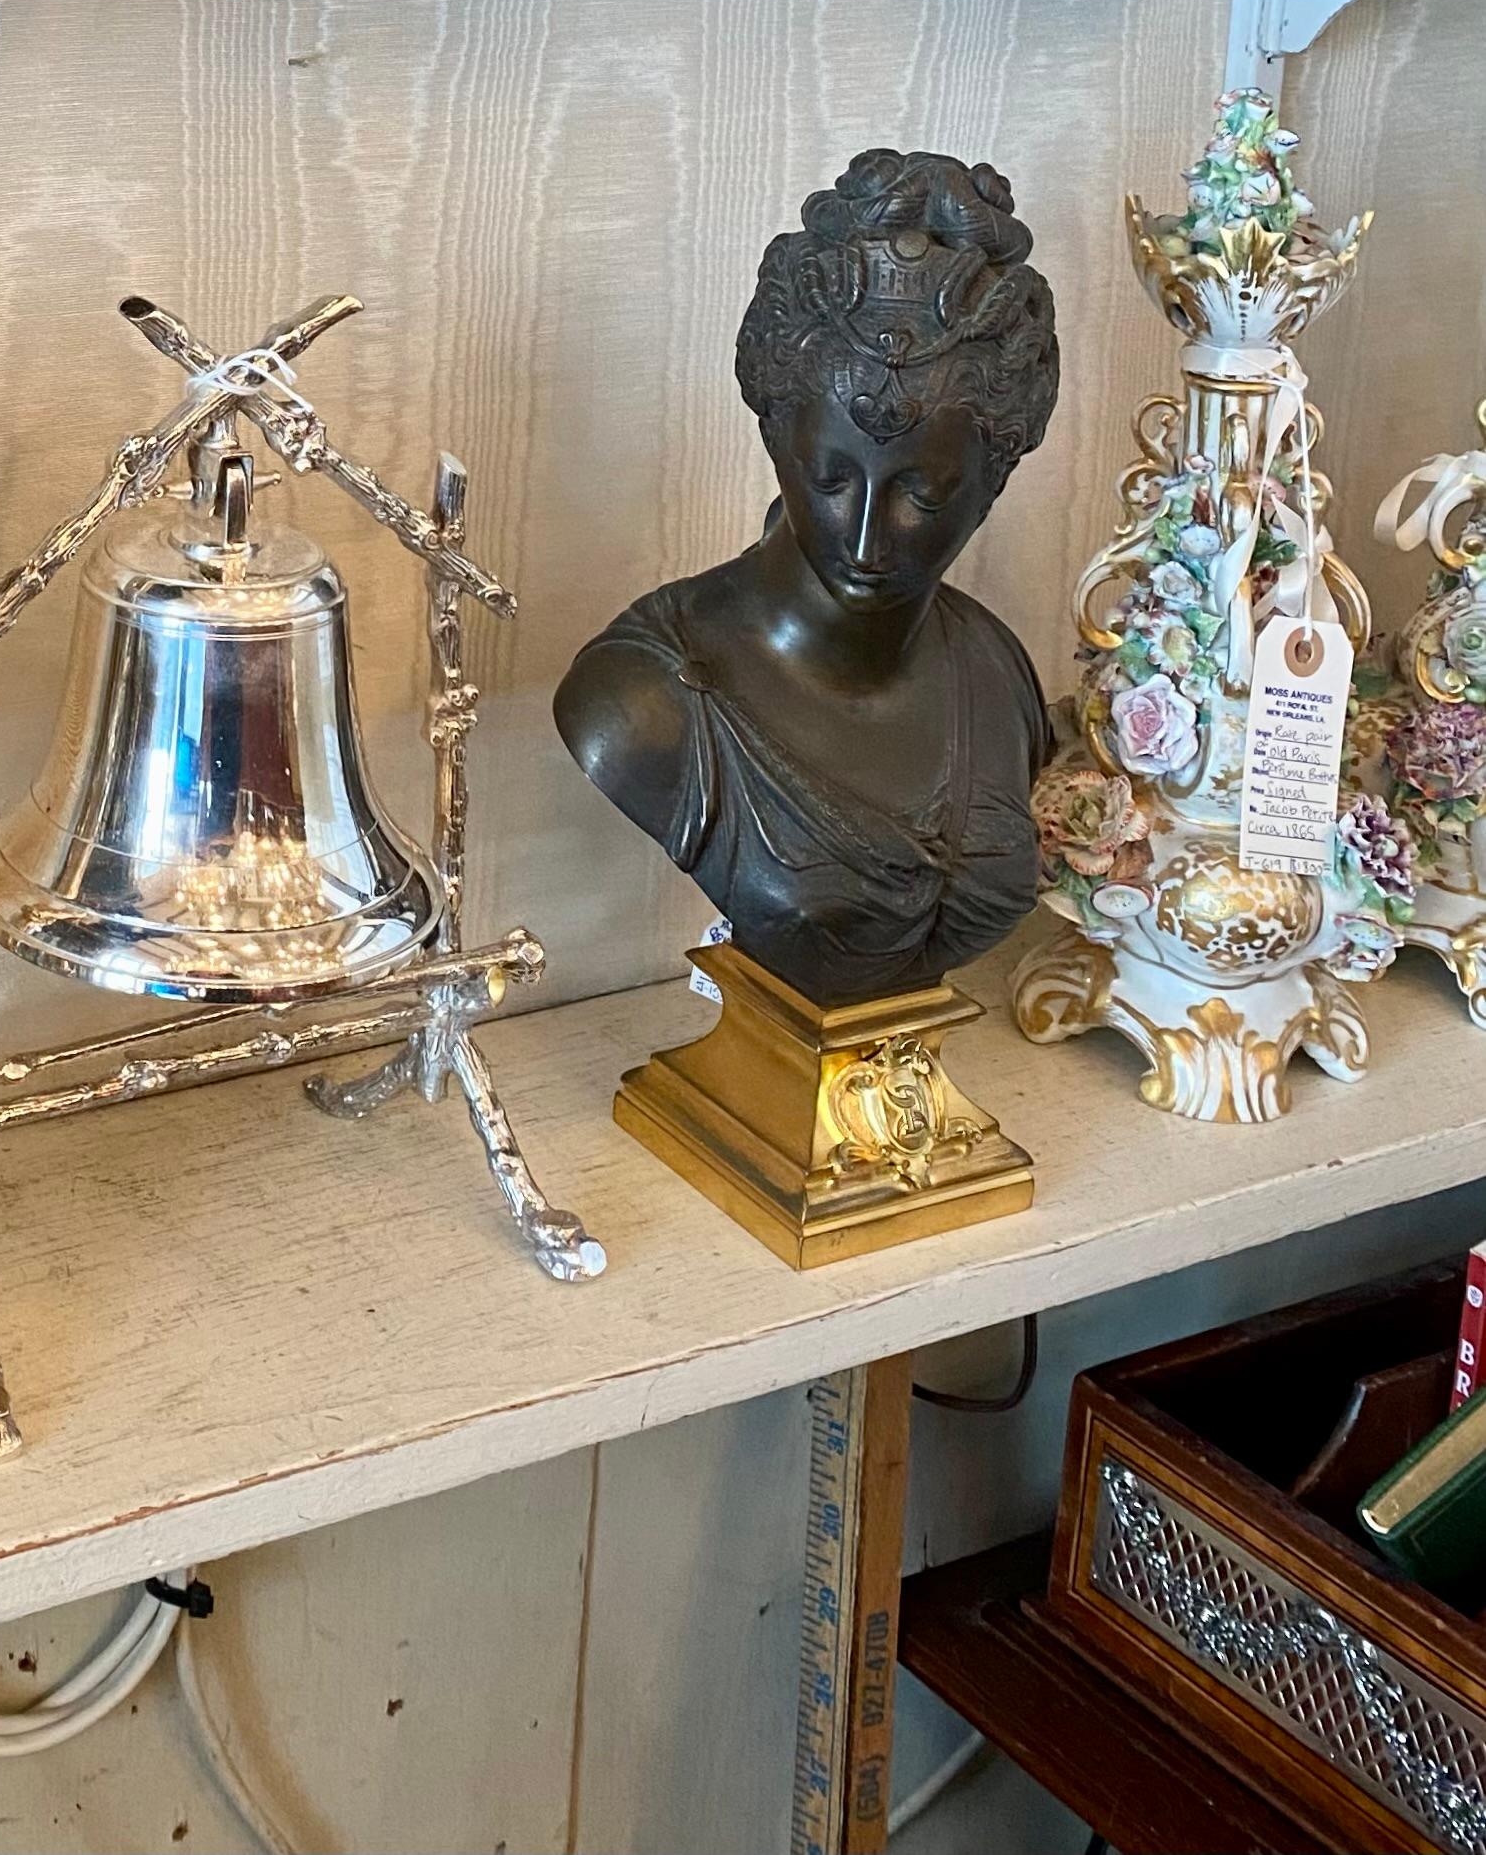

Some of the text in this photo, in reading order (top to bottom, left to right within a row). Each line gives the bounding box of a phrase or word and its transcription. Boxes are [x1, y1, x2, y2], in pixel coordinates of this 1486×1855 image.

[1265, 686, 1333, 704] MOSS ANTIQUES
[1306, 729, 1333, 746] pair
[1267, 780, 1307, 803] Signed
[1263, 800, 1298, 815] Jacob
[1286, 823, 1316, 840] 1865
[827, 1419, 847, 1456] 31
[818, 1586, 837, 1626] 29
[814, 1672, 834, 1709] 28
[808, 1754, 829, 1797] 27
